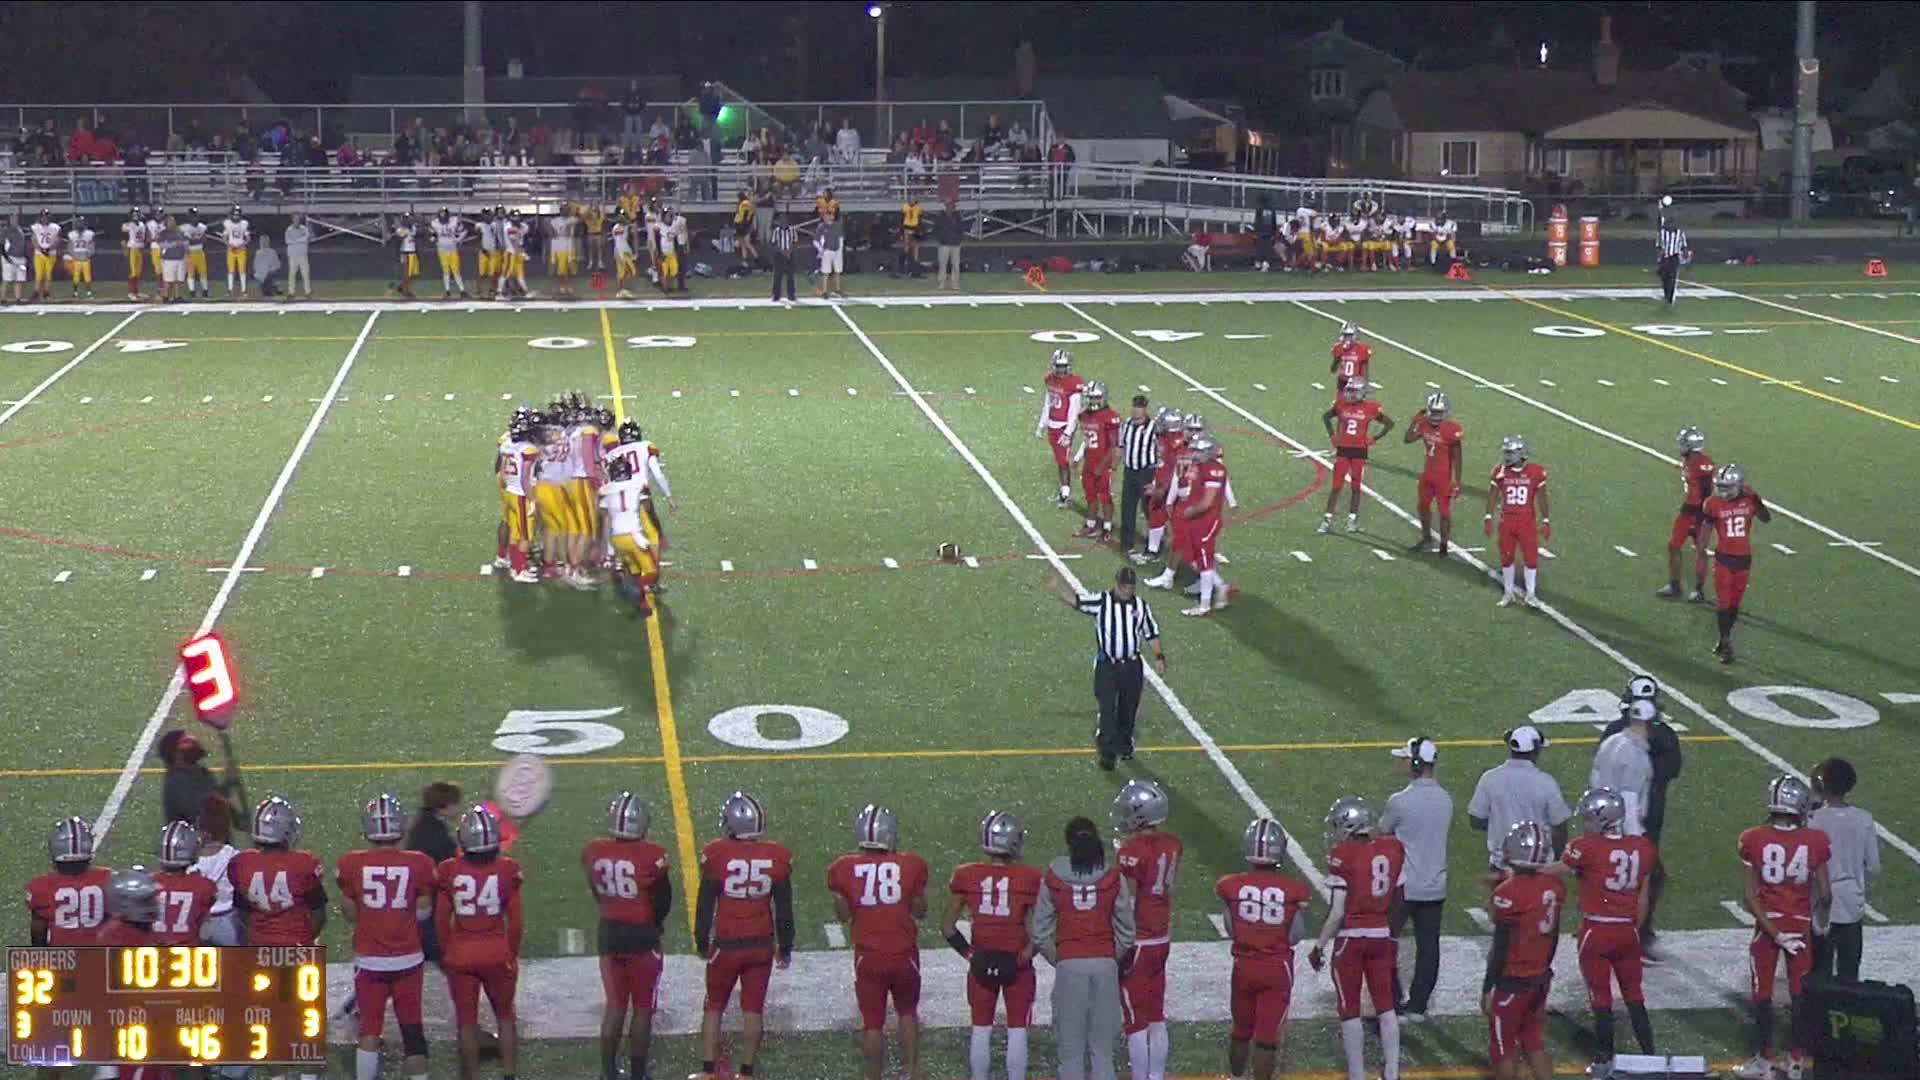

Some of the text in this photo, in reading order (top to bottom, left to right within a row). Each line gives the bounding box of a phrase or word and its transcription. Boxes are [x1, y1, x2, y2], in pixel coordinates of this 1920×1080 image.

[1346, 420, 1357, 435] 2
[1506, 486, 1528, 505] 29
[1726, 516, 1745, 537] 12
[183, 638, 233, 711] 3
[491, 706, 850, 755] 50
[594, 860, 638, 899] 36
[725, 860, 772, 899] 25
[854, 863, 900, 905] 78
[1371, 856, 1388, 897] 8
[1605, 849, 1640, 891] 31
[1761, 843, 1809, 886] 84
[54, 887, 103, 929] 20
[248, 871, 293, 911] 44
[362, 867, 410, 909] 57
[453, 875, 501, 916] 24
[978, 877, 1010, 916] 11
[152, 891, 193, 933] 17
[1539, 890, 1556, 933] 3
